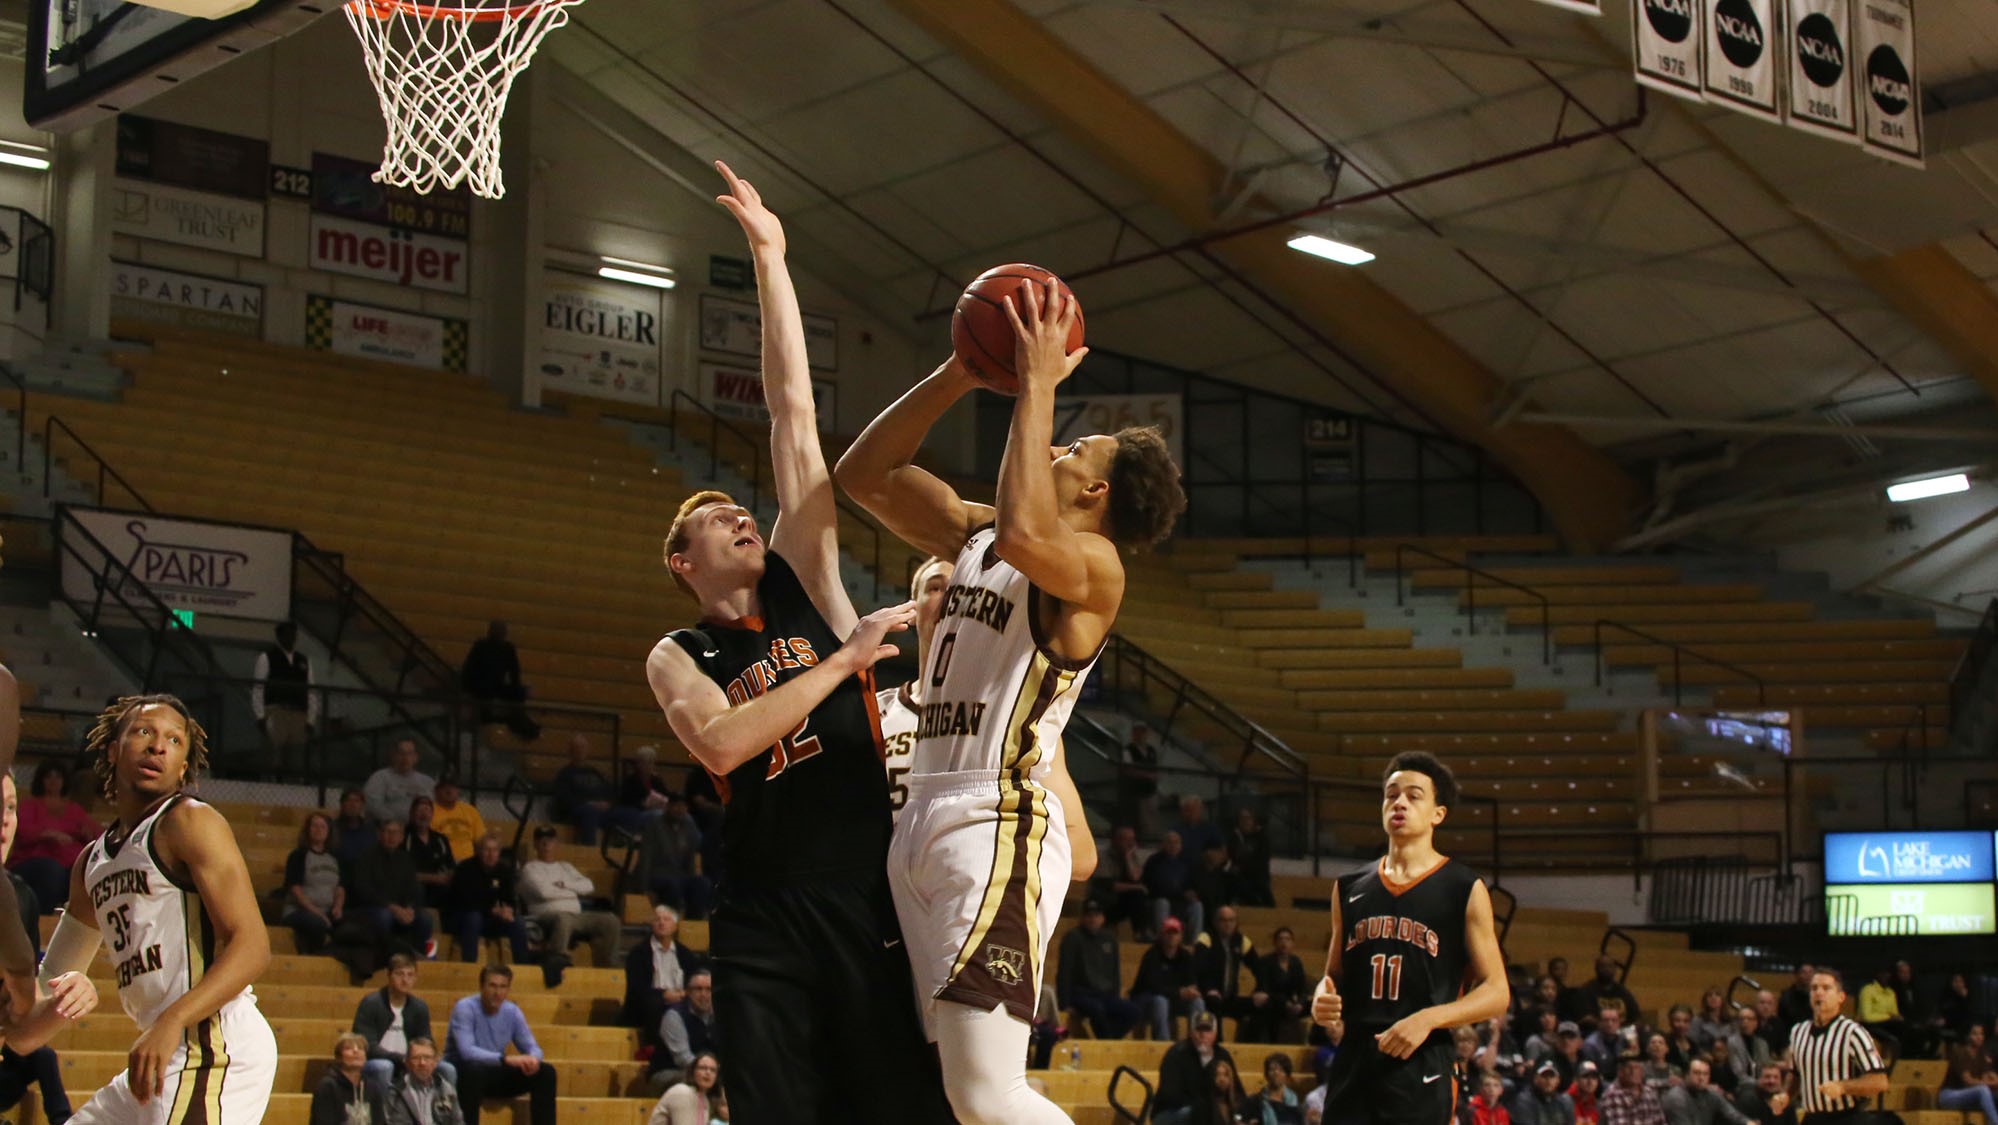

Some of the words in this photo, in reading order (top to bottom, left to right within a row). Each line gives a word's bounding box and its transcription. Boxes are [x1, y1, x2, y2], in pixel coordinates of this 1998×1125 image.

[1716, 12, 1760, 45] NCAA
[1658, 54, 1685, 76] 1976
[1799, 35, 1841, 66] NCAA
[1871, 74, 1910, 101] NCAA
[1808, 100, 1838, 119] 2004
[273, 170, 309, 195] 212
[155, 198, 257, 229] GREENLEAF
[178, 218, 237, 242] TRUST
[318, 228, 460, 286] meijer
[117, 273, 259, 314] SPARTAN
[546, 302, 656, 346] EIGLER
[932, 633, 956, 687] 0
[1892, 841, 1931, 855] LAKE
[1892, 854, 1971, 870] MICHIGAN
[90, 868, 152, 909] ESTERN
[1345, 915, 1439, 957] LOURDES
[1928, 914, 1985, 931] TRUST
[1371, 953, 1403, 1001] 11
